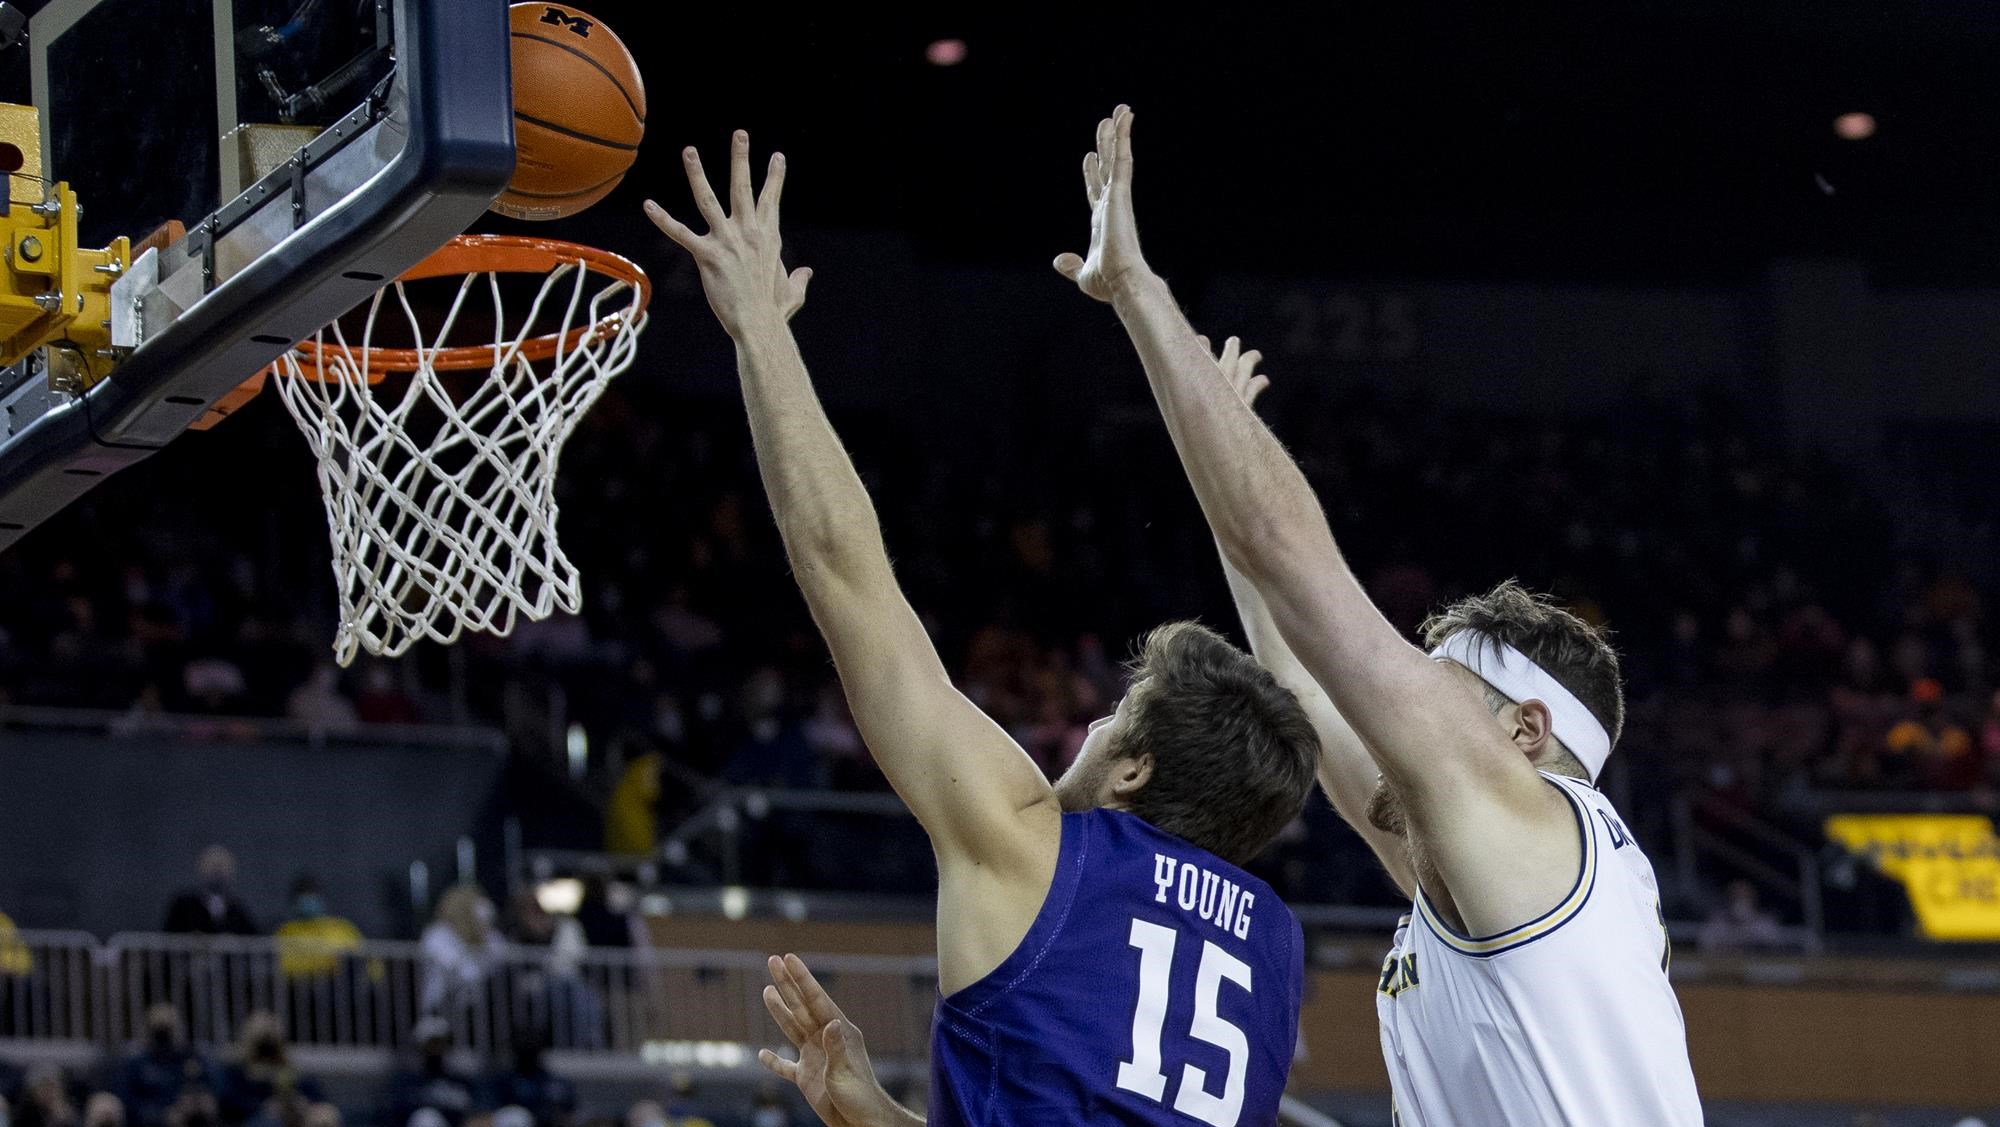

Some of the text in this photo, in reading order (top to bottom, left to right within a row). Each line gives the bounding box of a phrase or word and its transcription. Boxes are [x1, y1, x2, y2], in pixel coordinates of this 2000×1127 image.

[541, 7, 593, 38] M
[1277, 292, 1417, 357] 225
[1154, 853, 1255, 940] YOUNG
[1116, 917, 1252, 1127] 15
